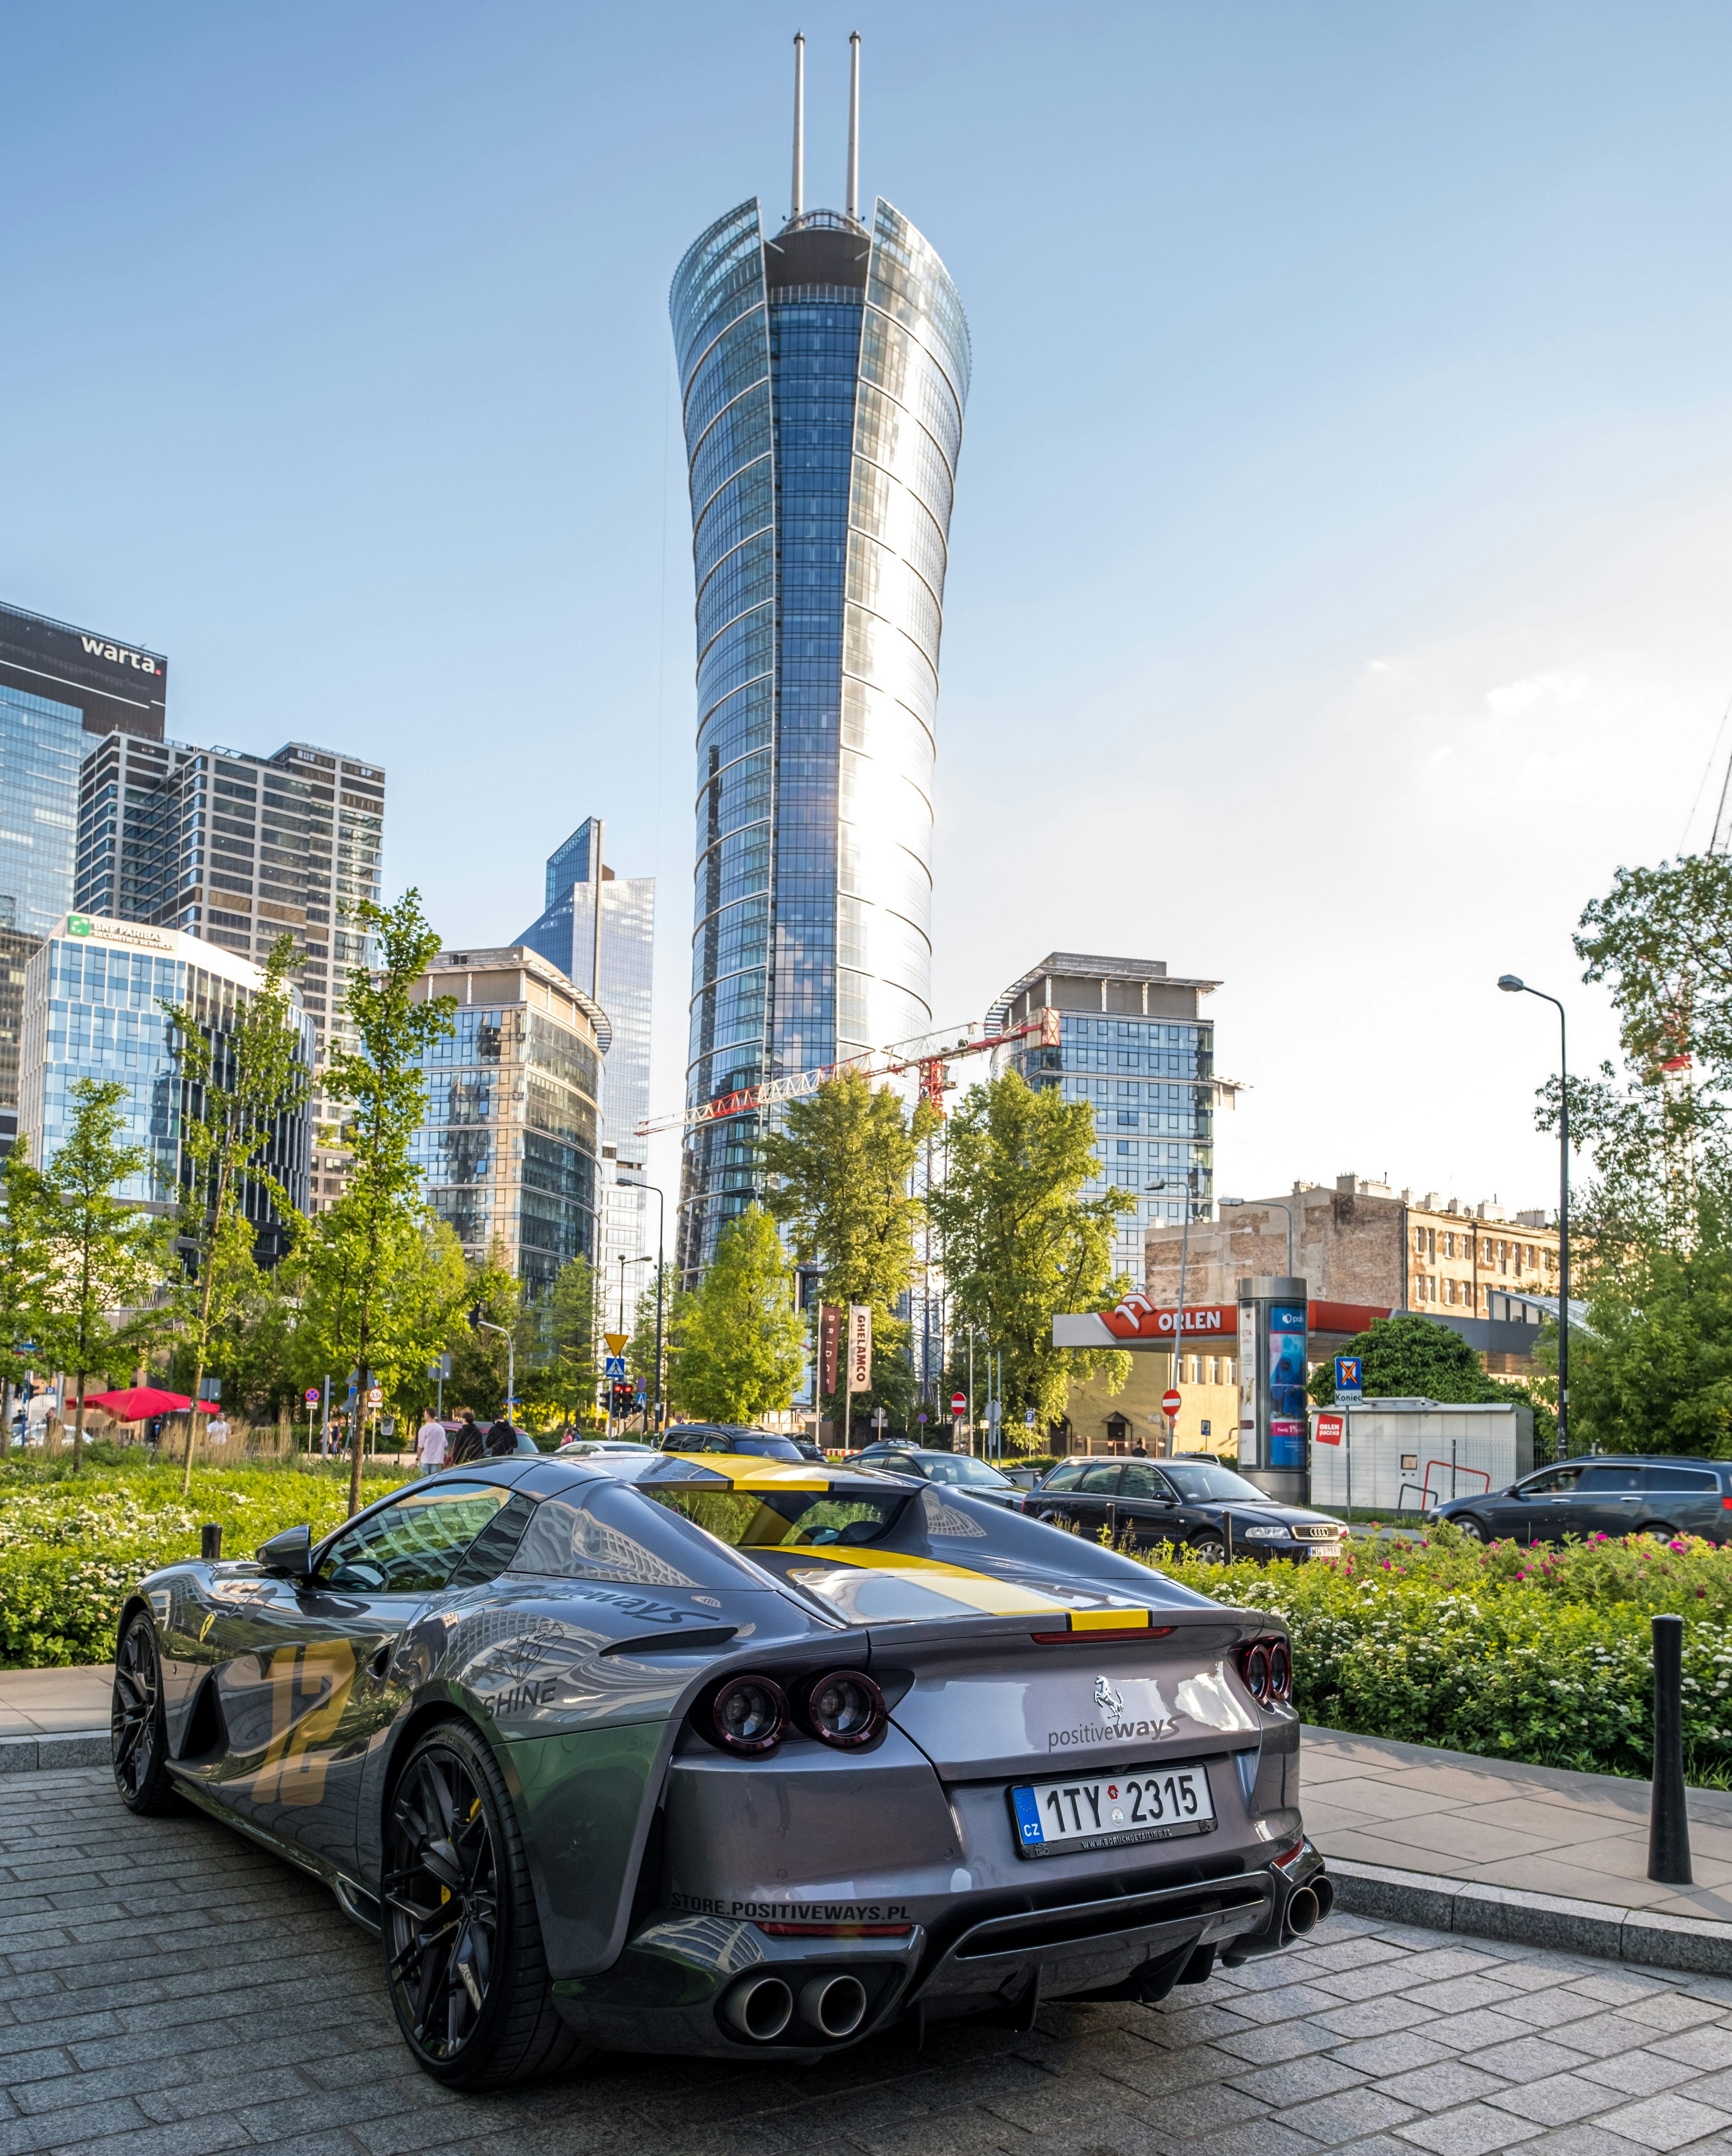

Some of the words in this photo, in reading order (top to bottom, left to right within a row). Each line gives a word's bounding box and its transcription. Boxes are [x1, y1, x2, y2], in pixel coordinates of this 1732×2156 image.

[94, 922, 118, 933] BNP
[119, 926, 165, 942] PARIBAS
[94, 931, 139, 944] SECURITIES
[139, 939, 175, 951] SERVICES
[1158, 1310, 1221, 1331] ORLEN
[856, 1314, 866, 1382] GHELAMCO
[1335, 1393, 1362, 1401] Koniec
[1312, 1547, 1321, 1556] WG
[484, 1676, 558, 1722] SHINE
[1048, 1714, 1187, 1753] positiveways
[1047, 1785, 1102, 1833] 1TY
[1126, 1775, 1198, 1823] 2315
[1023, 1823, 1040, 1837] CZ
[1082, 1829, 1172, 1849] WWW.BORUCHDETAILING.PL
[671, 1892, 911, 1920] STORE.POSITIVEWAYS.PL
